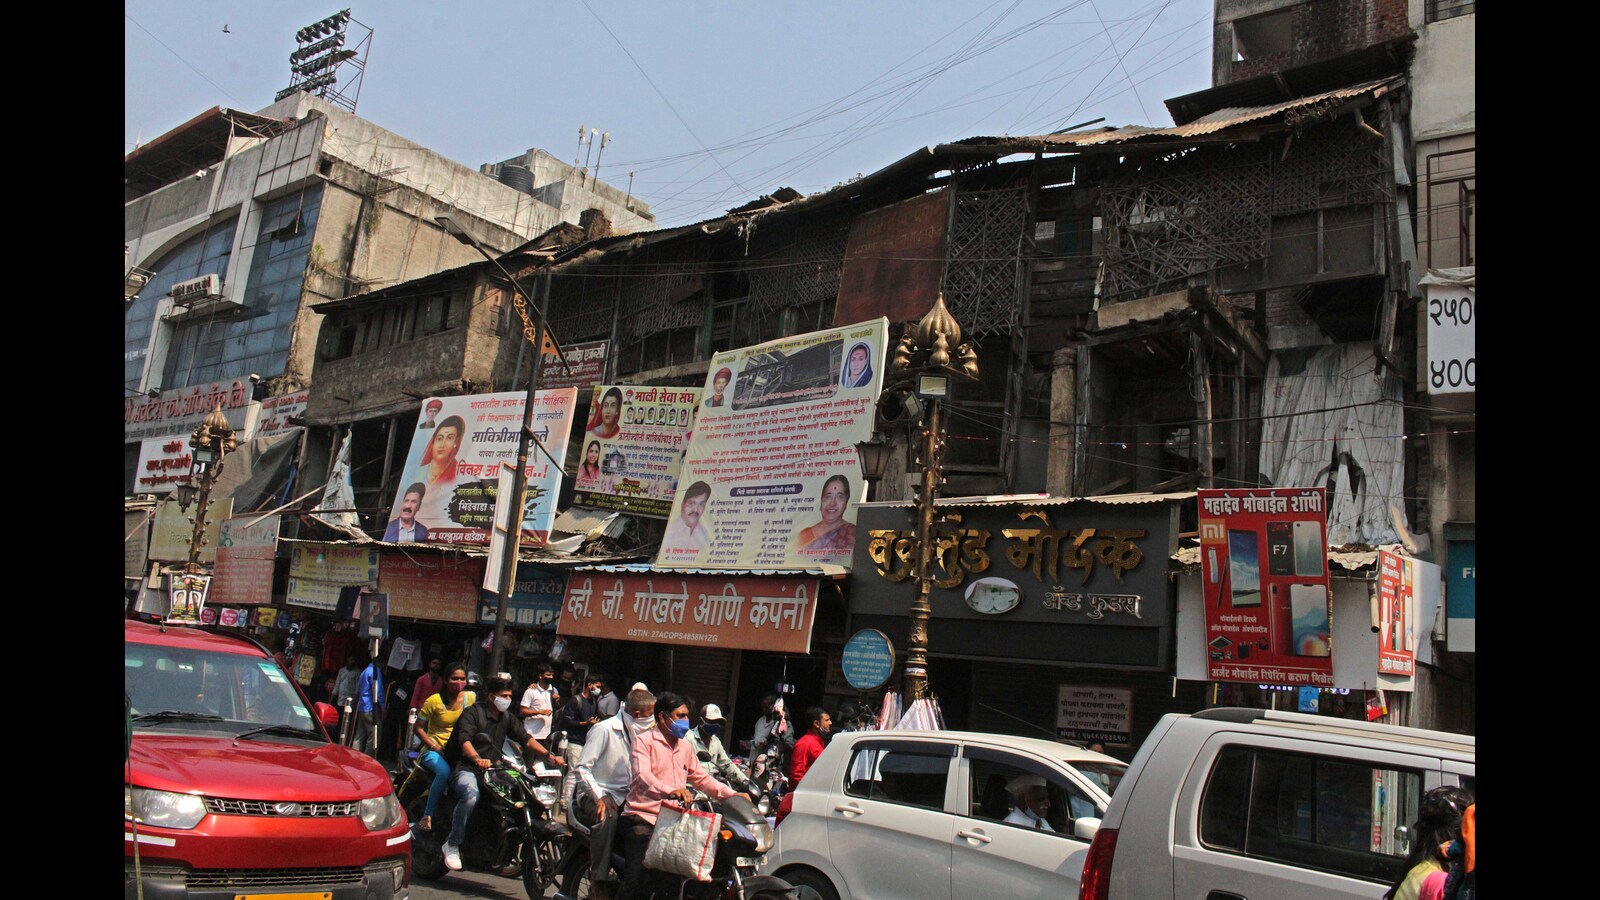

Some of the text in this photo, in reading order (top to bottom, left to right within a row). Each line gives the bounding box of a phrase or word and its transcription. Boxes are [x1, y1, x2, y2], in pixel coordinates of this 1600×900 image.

[635, 388, 695, 404] माळी सेवा संघ
[471, 398, 500, 409] भारतातील
[502, 399, 518, 407] प्रथम
[472, 427, 522, 443] सावित्रीमा
[456, 459, 484, 477] विनम्र
[459, 500, 487, 511] भिडेवाडा
[1203, 491, 1322, 516] महादेव मोबाईल शॉपी
[464, 530, 486, 542] वाडेकर
[1002, 510, 1150, 586] मोदक
[1273, 544, 1288, 555] F7
[567, 578, 593, 621] व्ही.
[601, 578, 624, 620] जी.
[633, 581, 689, 624] गोखले
[693, 583, 745, 627] आणि
[628, 628, 650, 637] GSTIN:
[1232, 668, 1259, 680] मोबाईल
